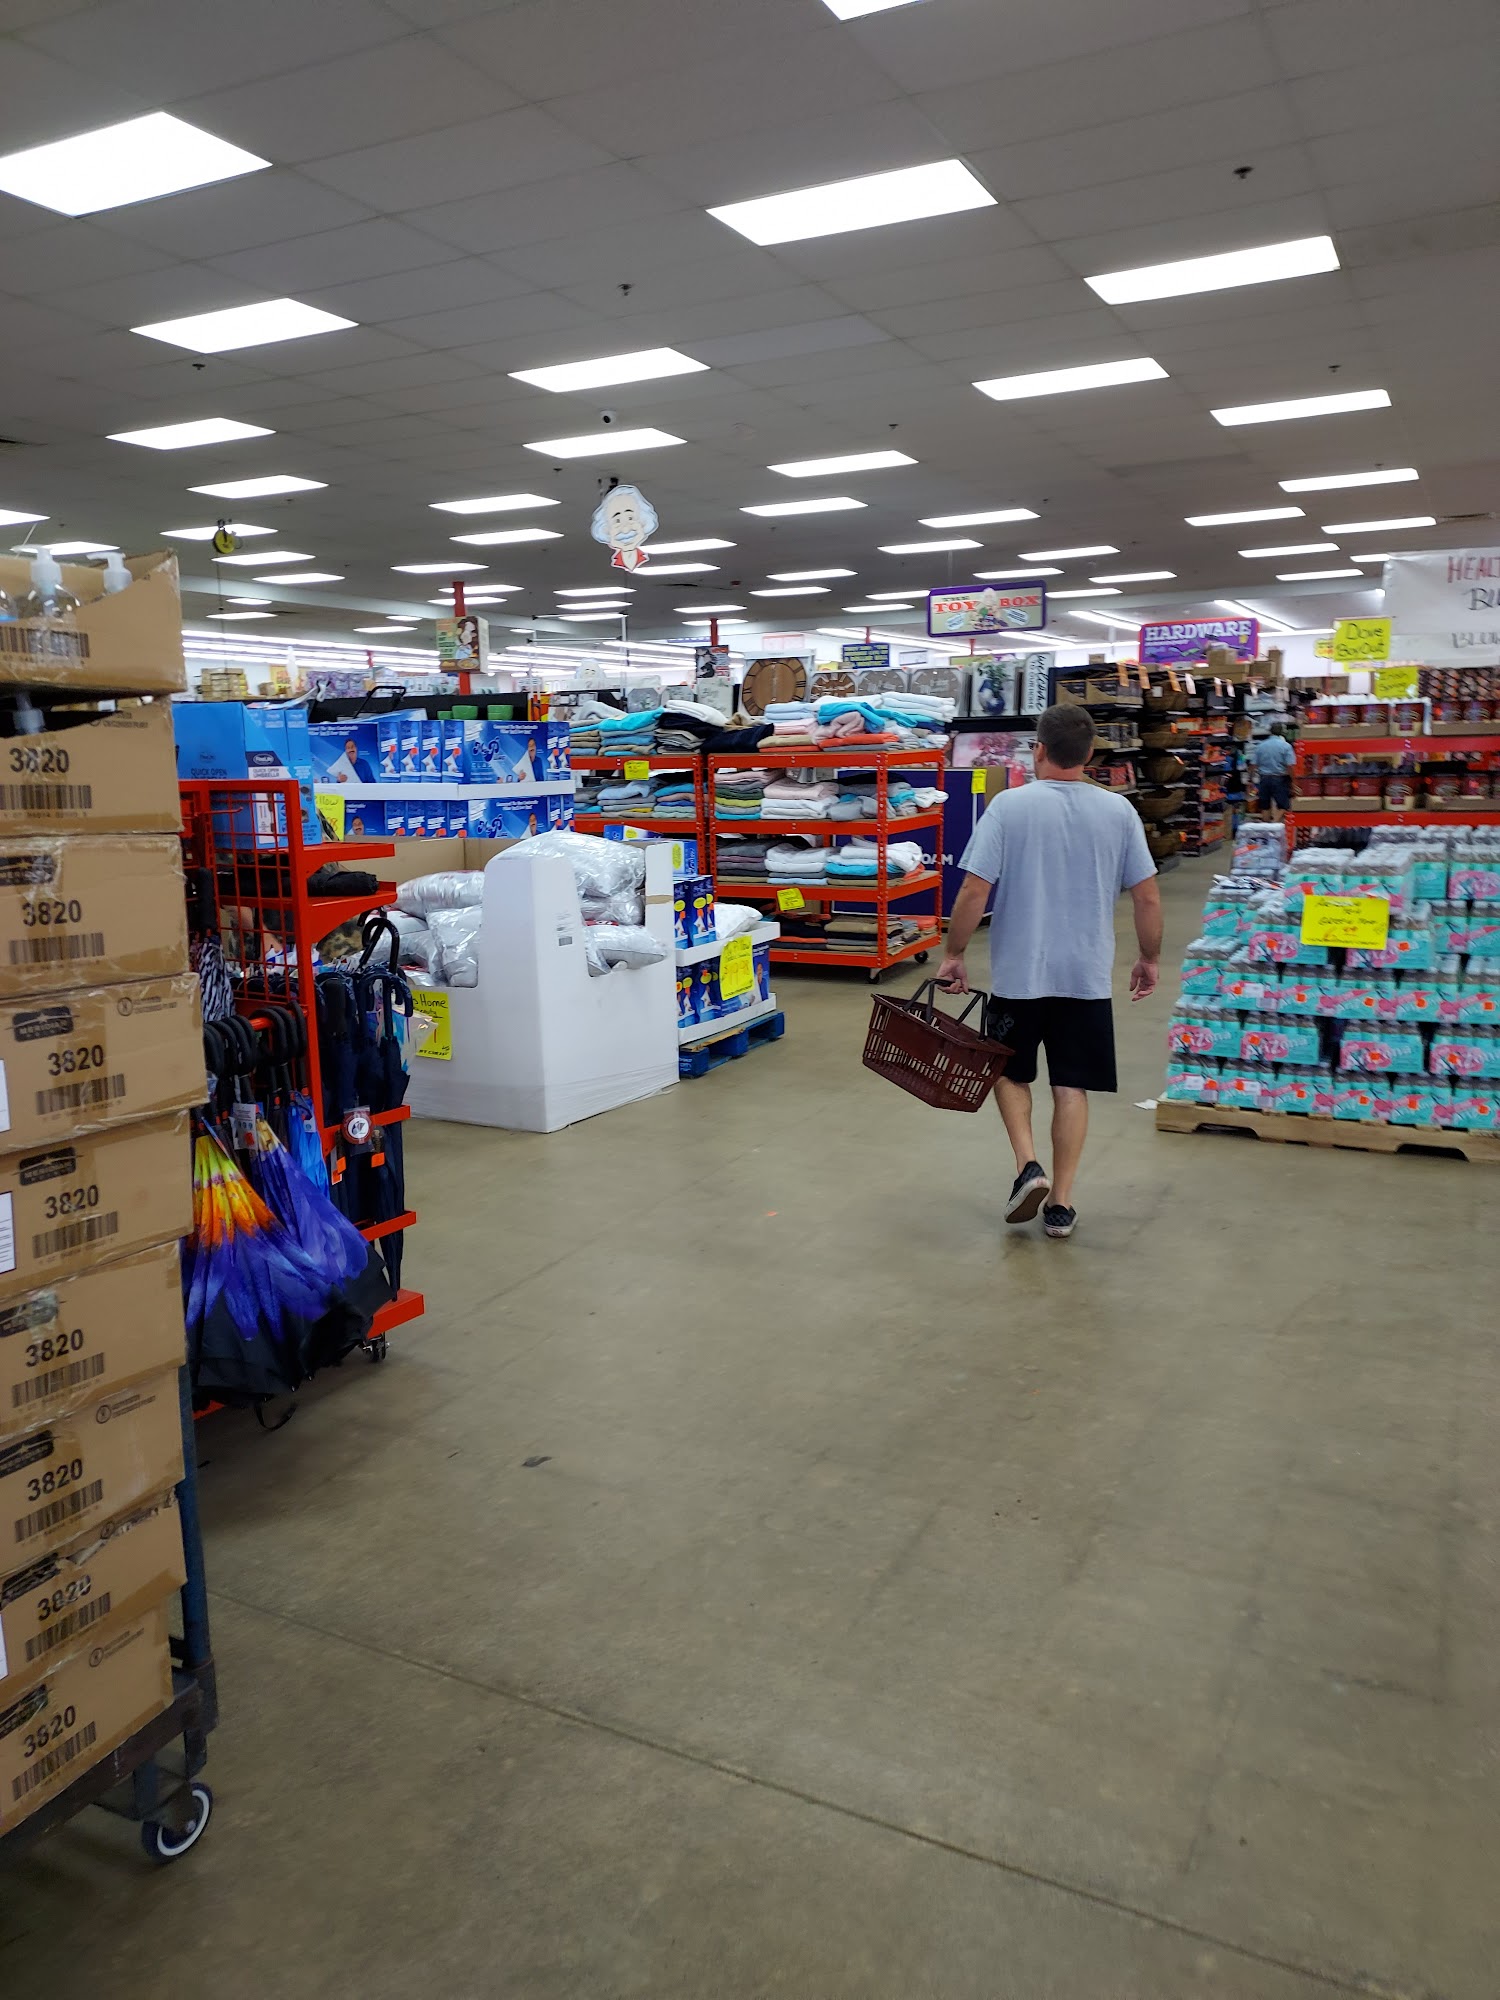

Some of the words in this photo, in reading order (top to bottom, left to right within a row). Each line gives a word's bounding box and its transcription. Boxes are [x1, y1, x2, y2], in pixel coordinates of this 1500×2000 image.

[934, 601, 977, 614] TOY
[1000, 595, 1039, 608] BOX
[1145, 620, 1252, 641] HARDWARE
[1346, 623, 1383, 640] Dove
[9, 749, 70, 773] 3820
[22, 899, 82, 926] 3820
[419, 993, 449, 1009] Home
[48, 1044, 104, 1076] 3820
[45, 1184, 99, 1219] 3820
[25, 1328, 84, 1367] 3820
[27, 1458, 83, 1501] 3820
[37, 1574, 91, 1621] 3820
[23, 1705, 76, 1758] 3820
